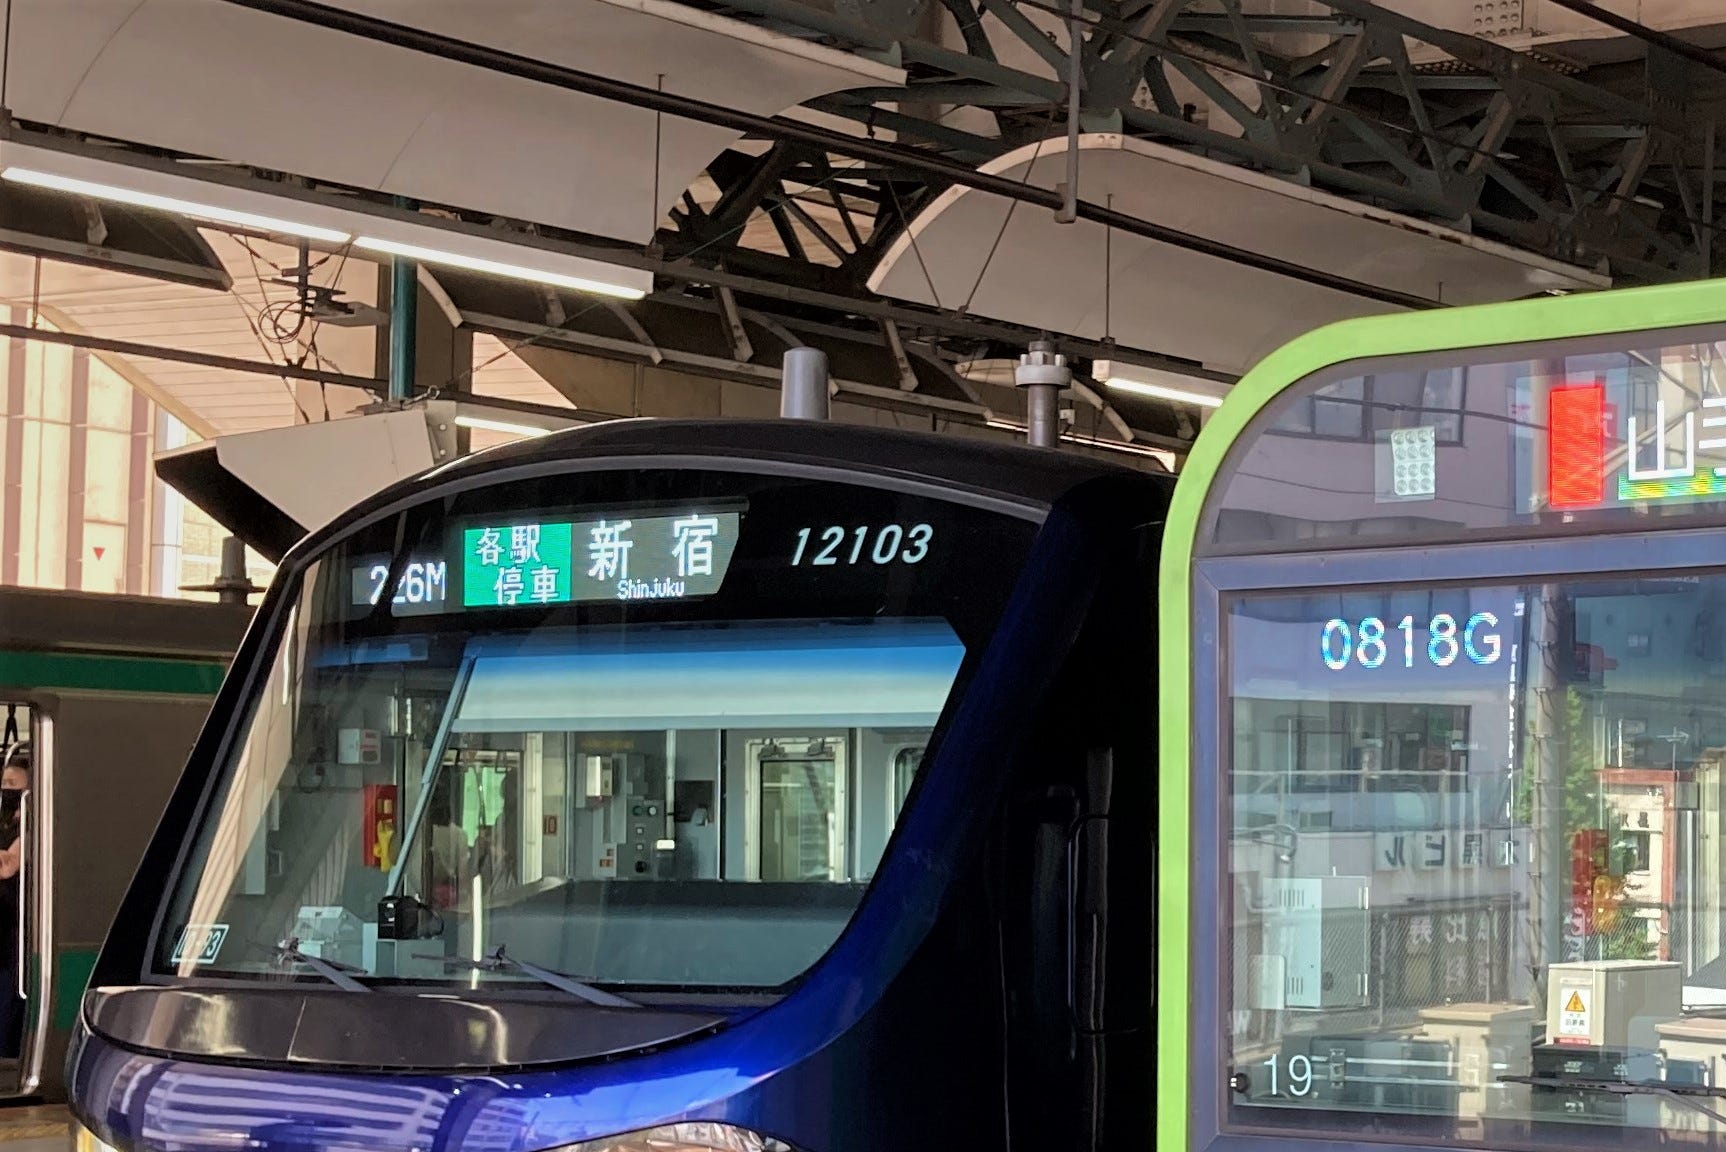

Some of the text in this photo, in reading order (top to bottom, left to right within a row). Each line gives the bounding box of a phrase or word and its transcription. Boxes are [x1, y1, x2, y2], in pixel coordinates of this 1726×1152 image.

[475, 524, 541, 566] 各駅
[588, 514, 719, 581] 新宿
[790, 523, 933, 567] 12103
[493, 565, 559, 606] 停車
[616, 577, 685, 600] Shinjuku
[1320, 611, 1501, 670] 0818G
[1262, 1054, 1314, 1097] 19
